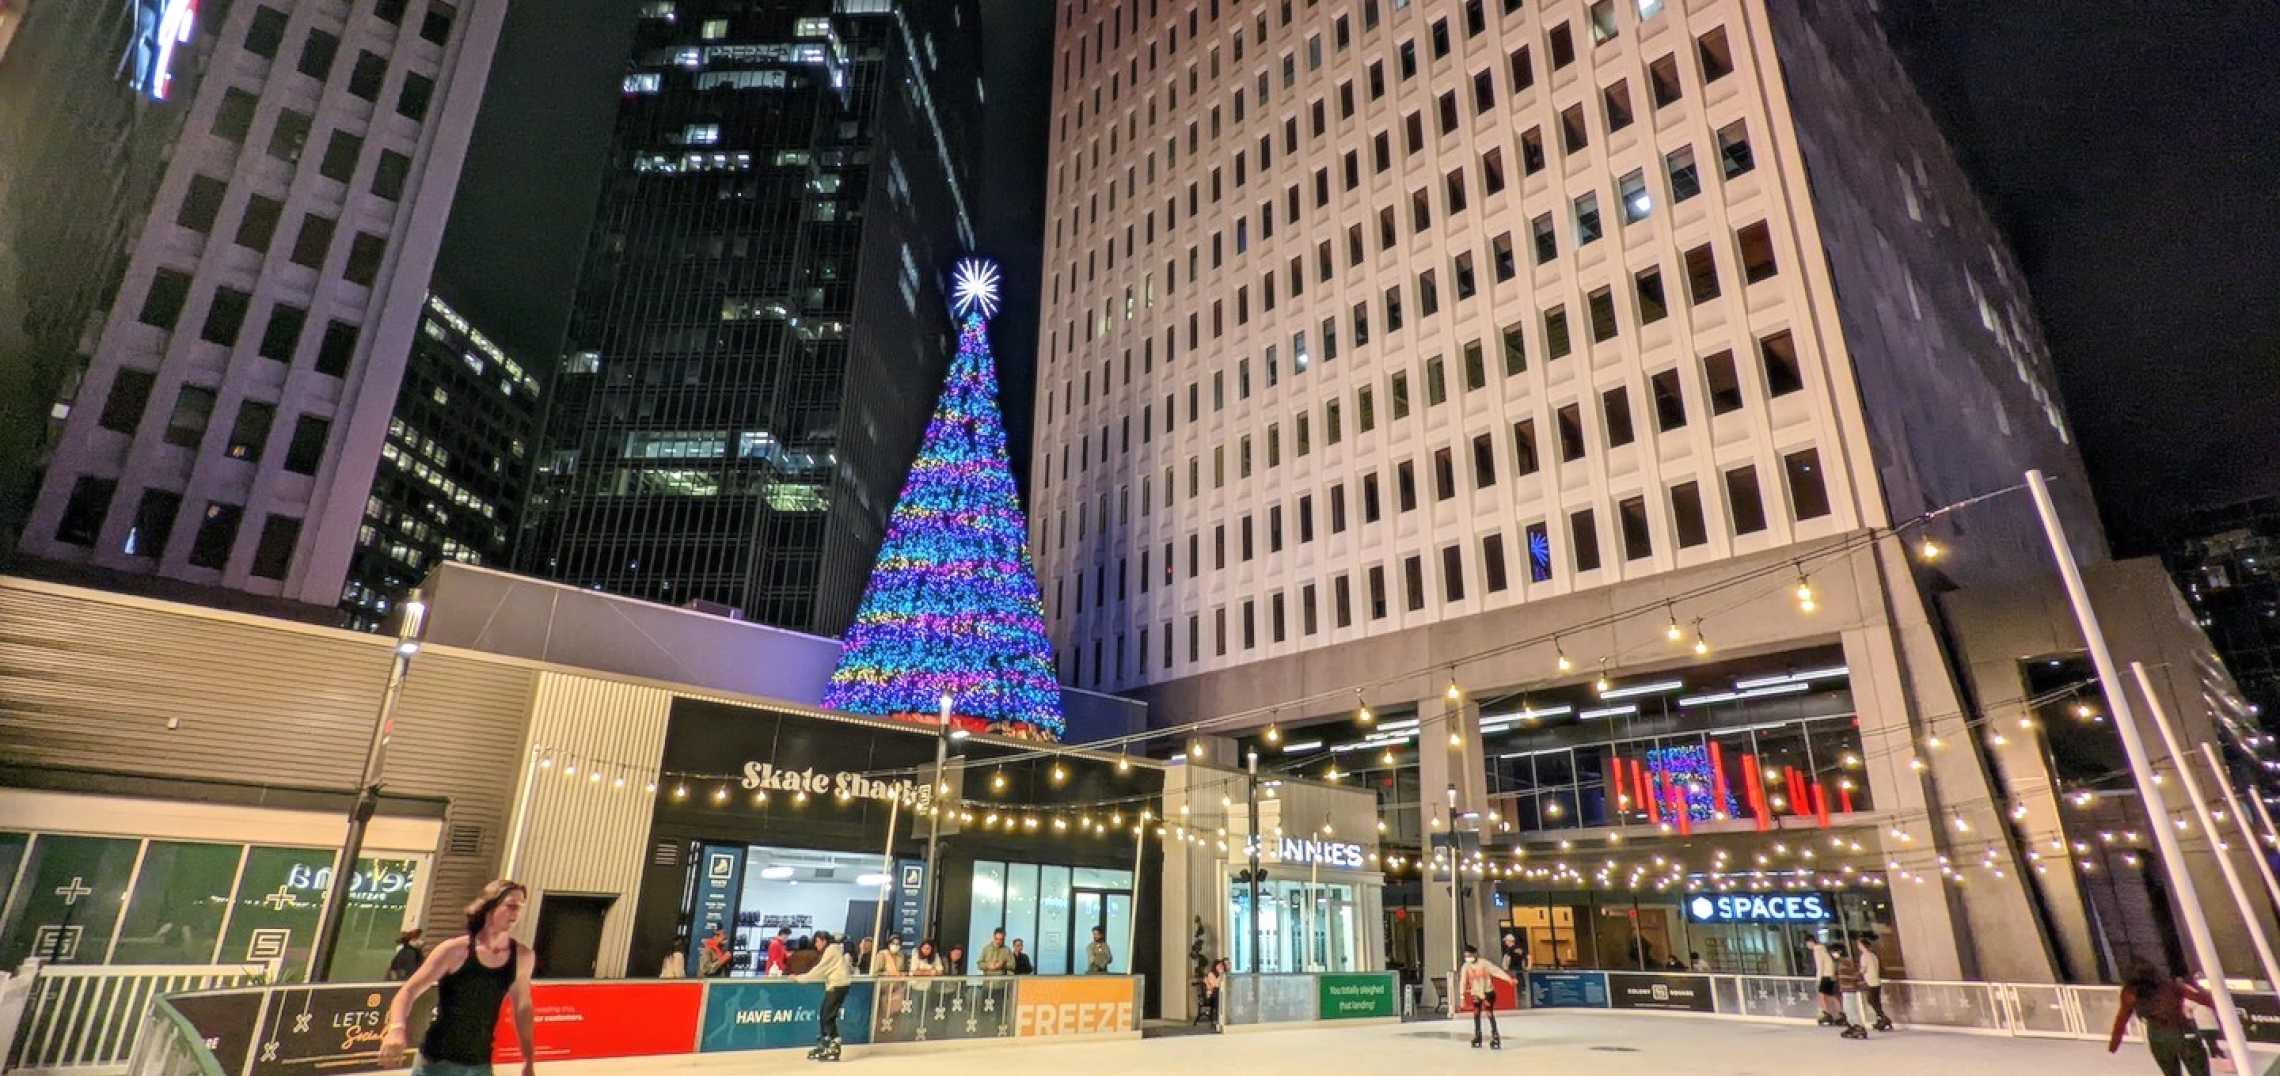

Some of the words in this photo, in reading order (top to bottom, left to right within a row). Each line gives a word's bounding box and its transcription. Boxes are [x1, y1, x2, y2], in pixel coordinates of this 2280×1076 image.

[742, 761, 829, 793] Skate
[333, 1010, 380, 1028] LET'S
[736, 1010, 772, 1024] HAVE
[773, 1009, 792, 1023] AN
[795, 1006, 814, 1022] ice
[1016, 1002, 1132, 1036] FREEZE
